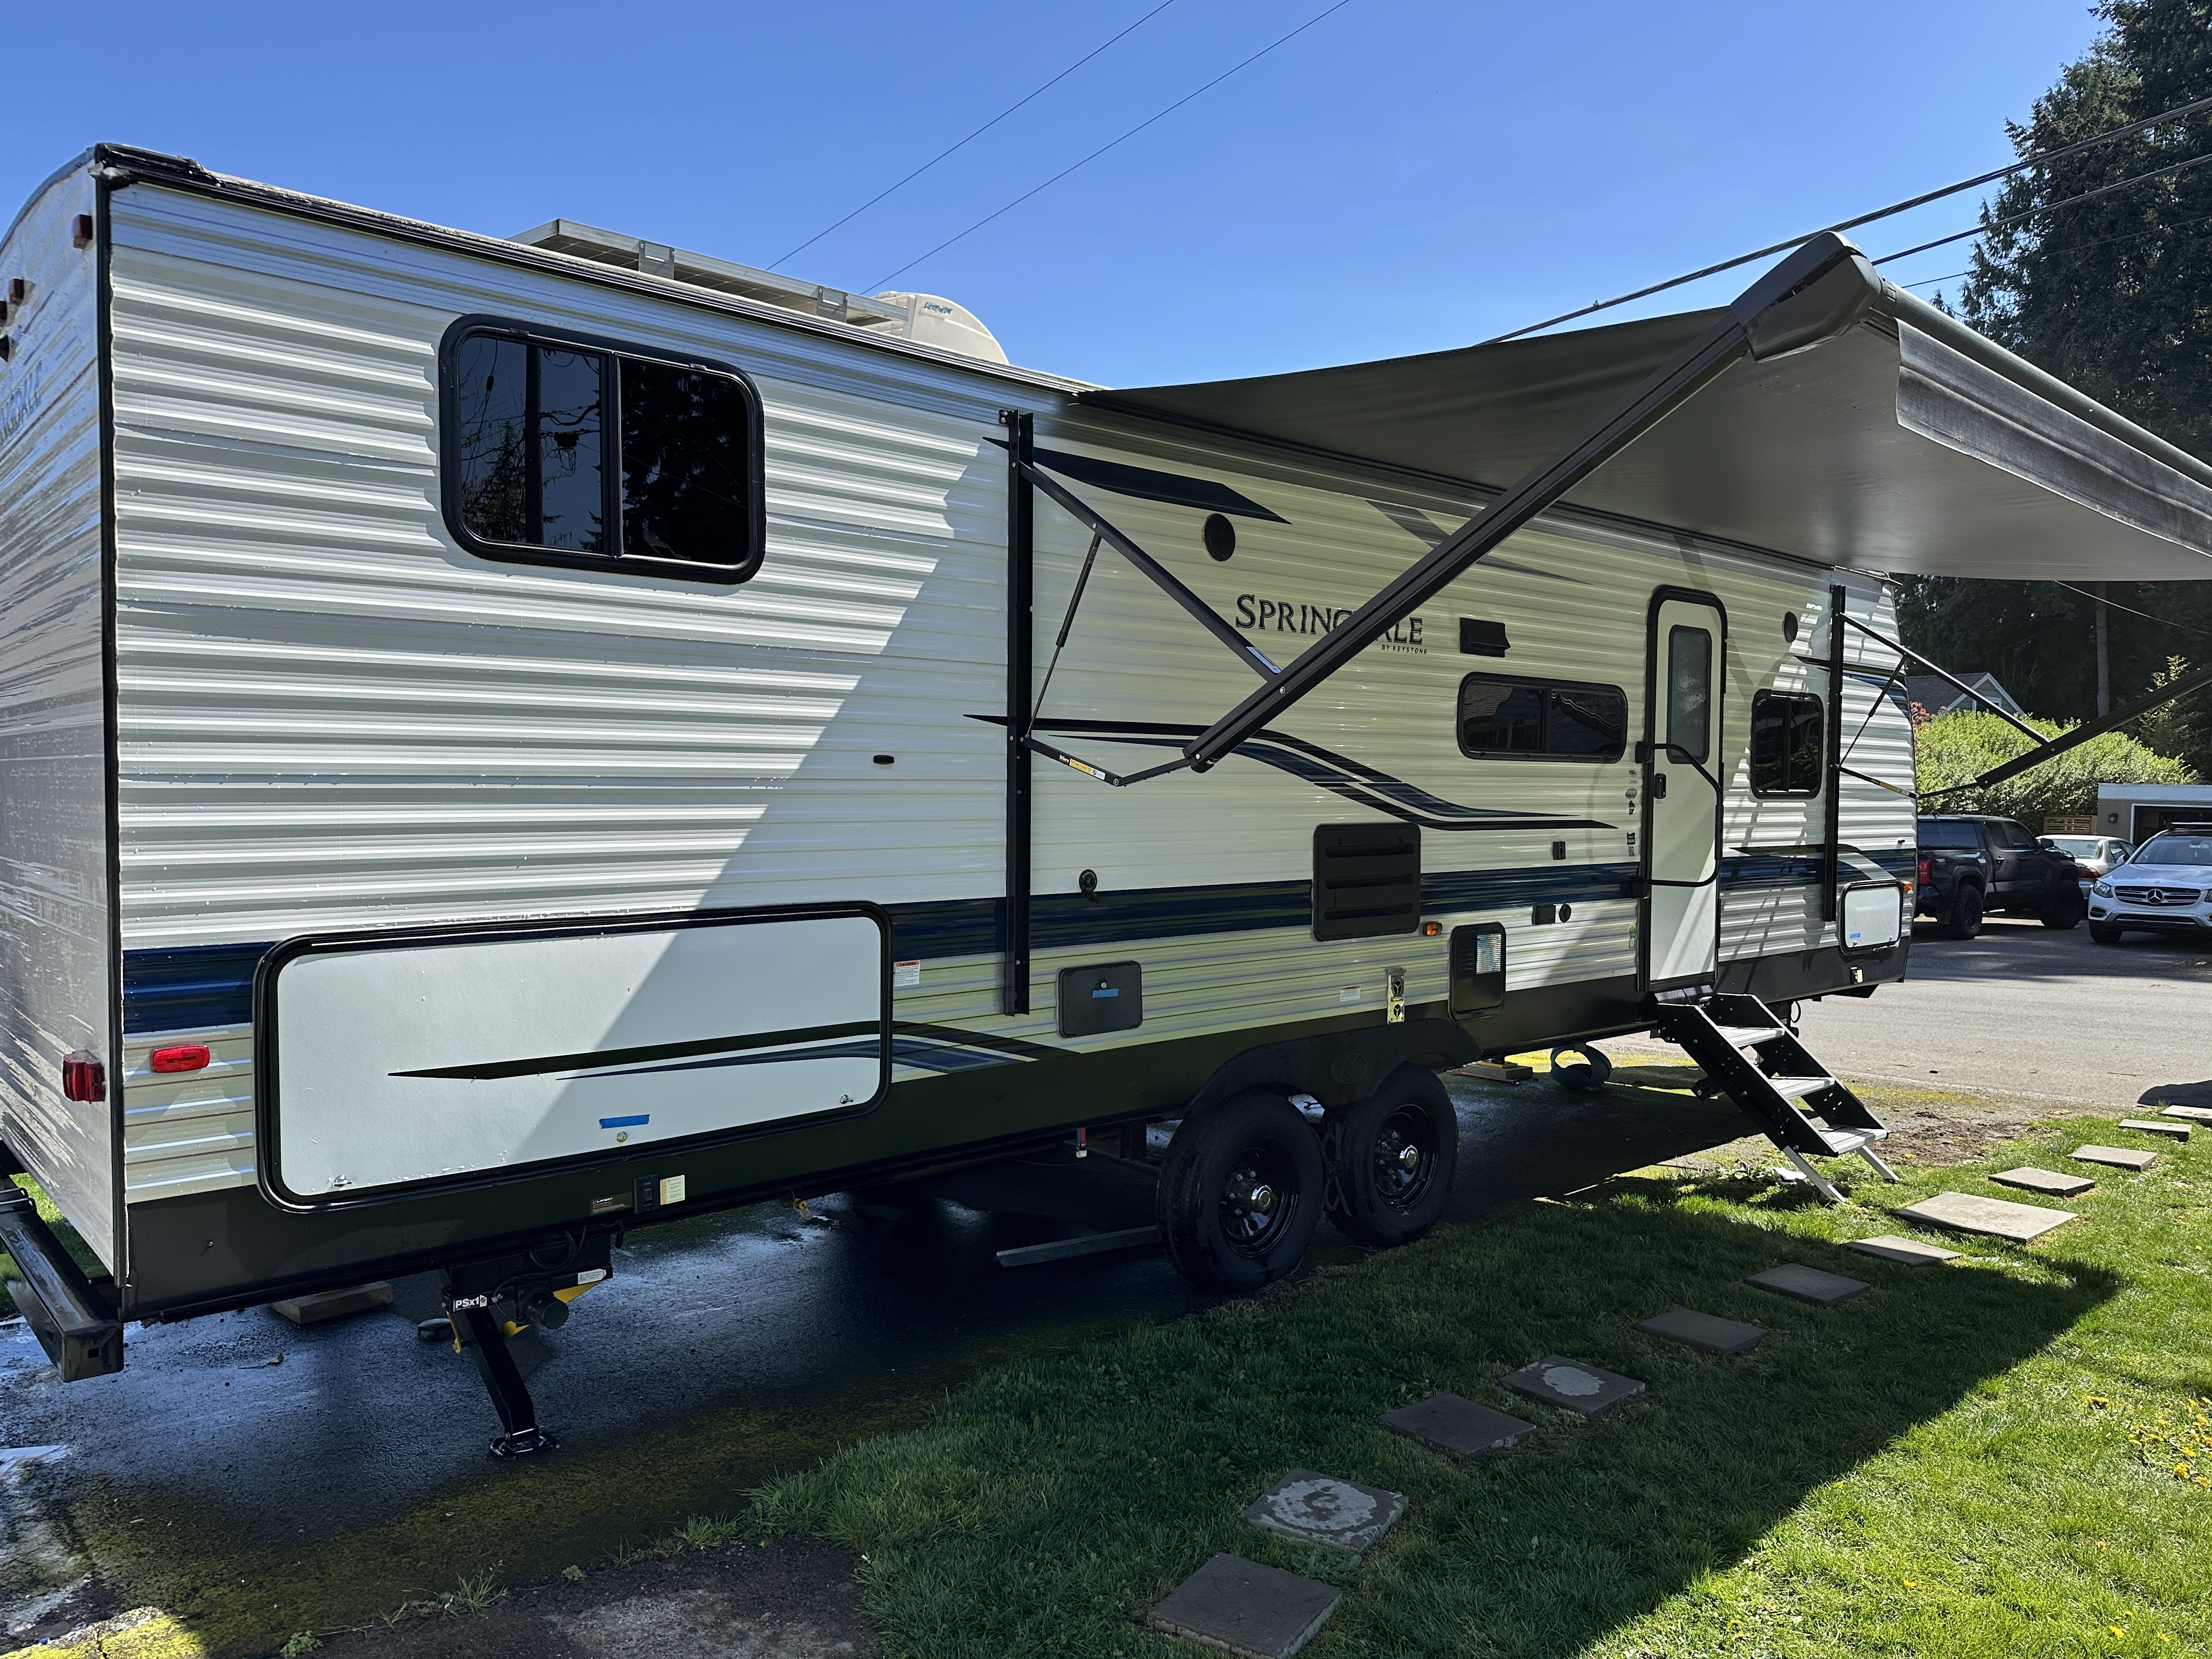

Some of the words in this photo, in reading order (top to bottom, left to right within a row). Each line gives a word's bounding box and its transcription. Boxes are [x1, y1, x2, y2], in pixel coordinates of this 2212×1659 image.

[1235, 593, 1423, 645] SPRINLE
[1393, 646, 1427, 654] KEYSTONE
[455, 1296, 479, 1309] PSx1
